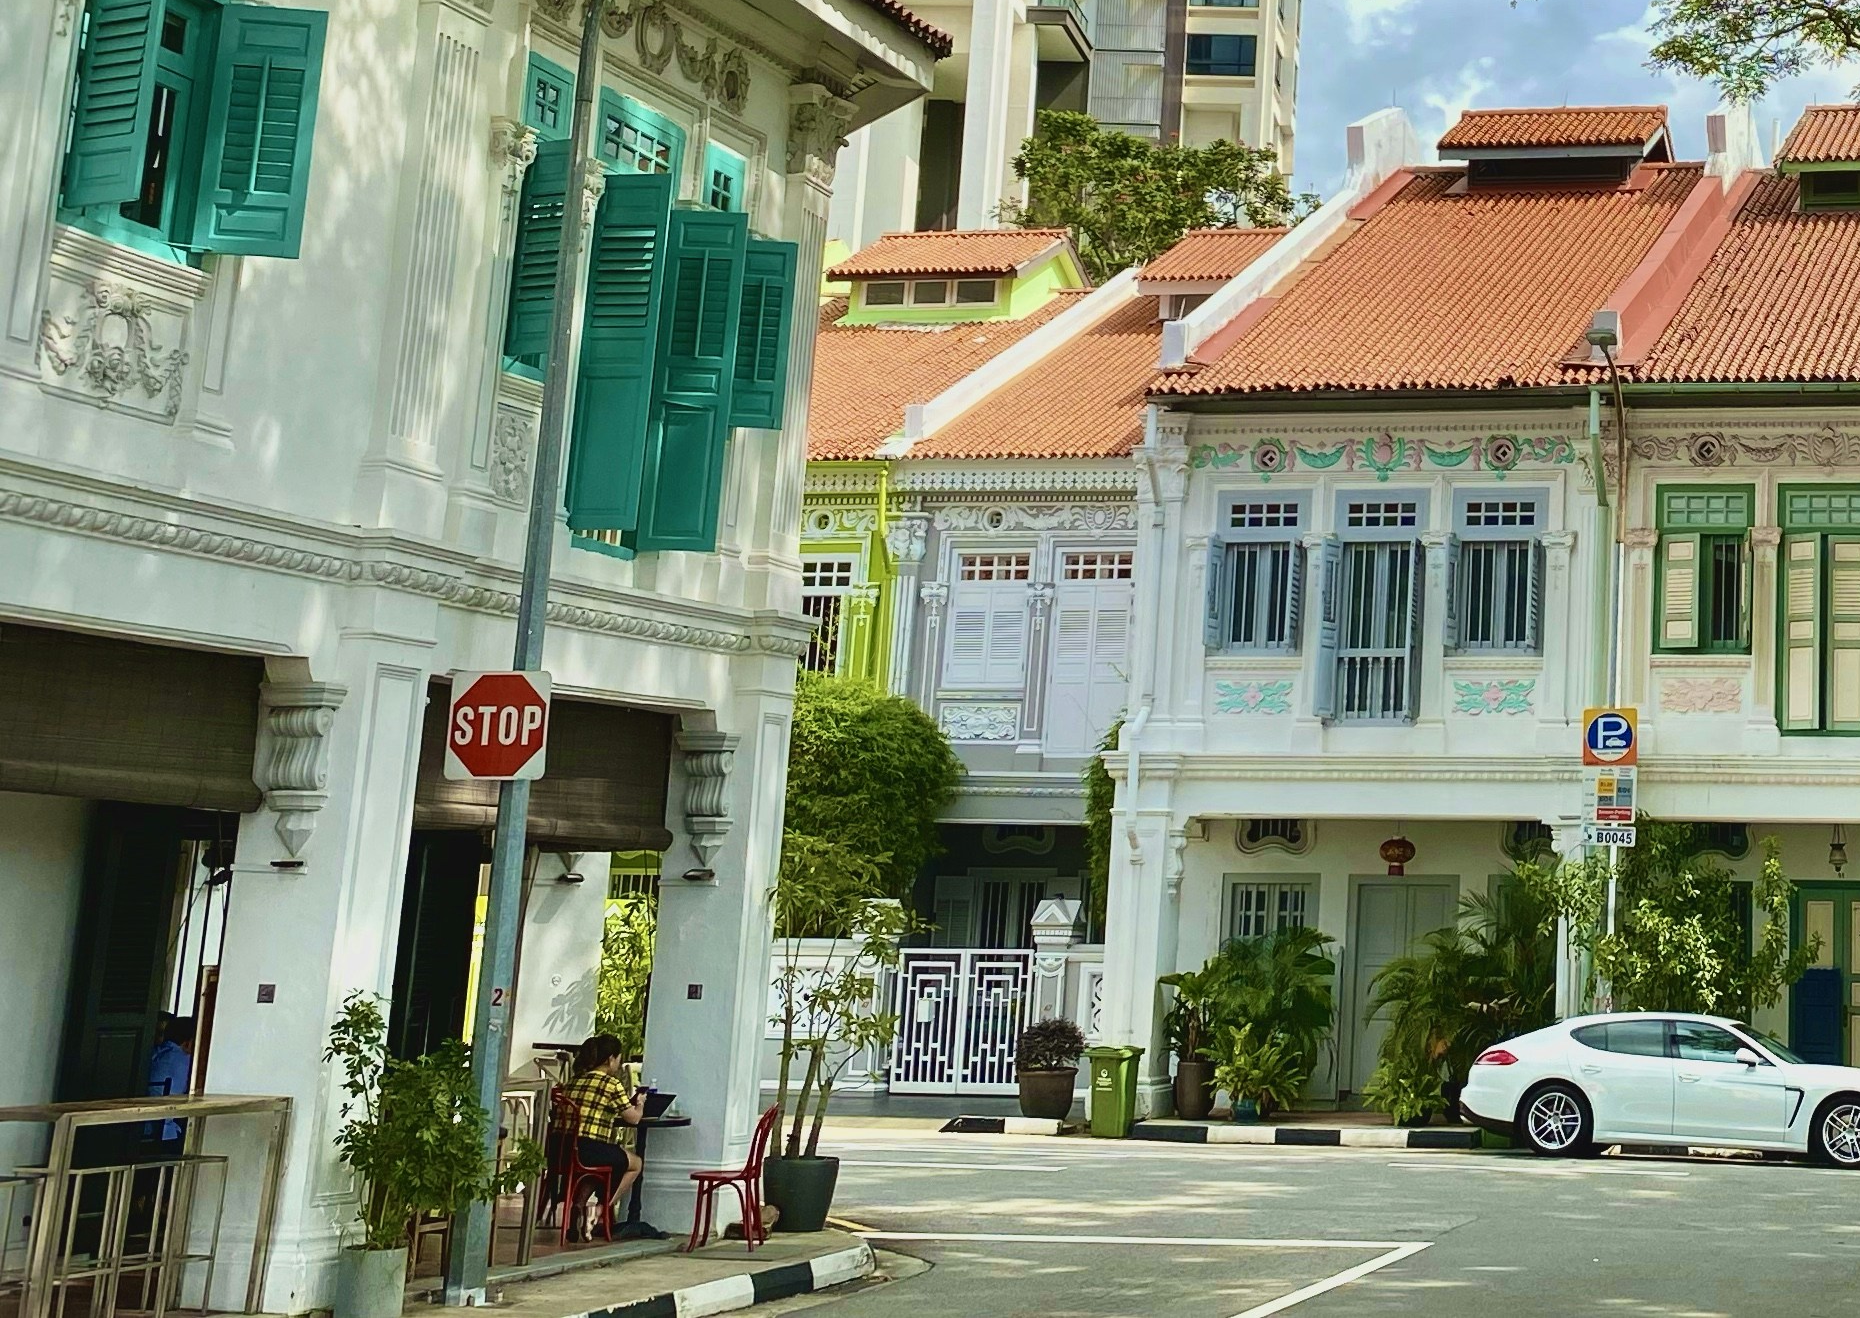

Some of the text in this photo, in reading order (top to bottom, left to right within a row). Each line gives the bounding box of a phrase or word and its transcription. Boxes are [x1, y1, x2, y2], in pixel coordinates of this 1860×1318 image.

[454, 705, 542, 746] STOP
[1597, 717, 1628, 749] P
[1596, 832, 1632, 844] B0045
[491, 988, 503, 1006] 2
